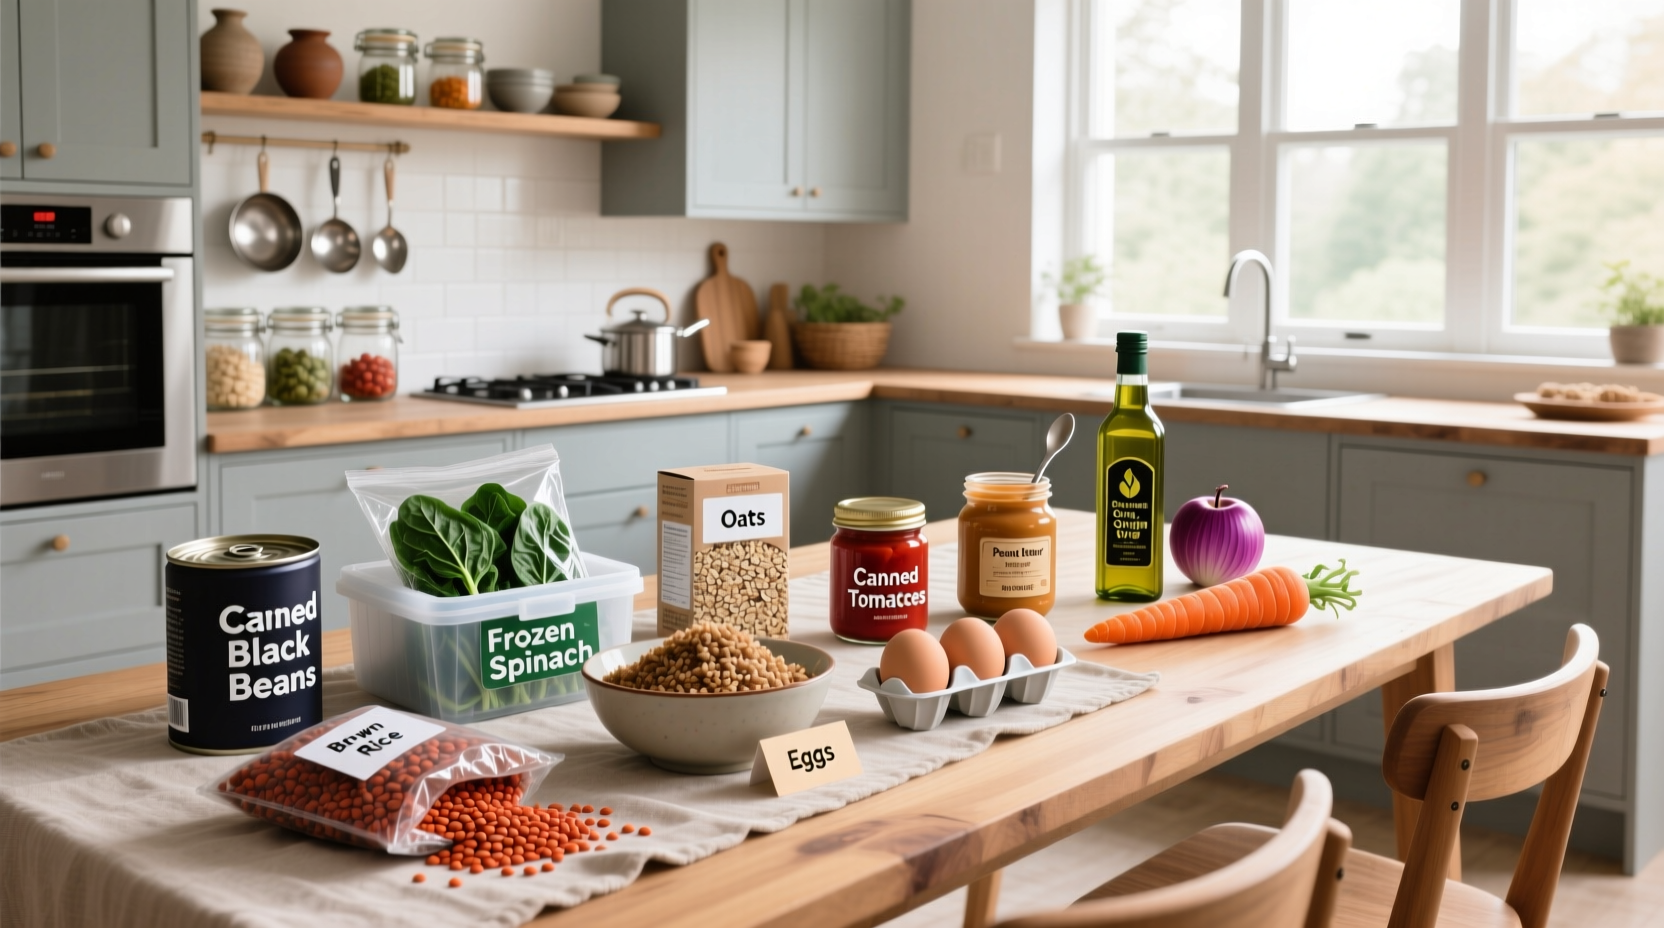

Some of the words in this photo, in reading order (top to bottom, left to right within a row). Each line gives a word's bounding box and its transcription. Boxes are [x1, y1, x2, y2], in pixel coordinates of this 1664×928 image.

[721, 509, 766, 528] Oats
[853, 565, 919, 586] Canned
[228, 629, 311, 668] Black
[487, 622, 575, 653] Frozen
[489, 640, 593, 683] Spinach
[229, 666, 317, 701] Beans
[356, 731, 404, 757] Rice
[787, 745, 835, 773] Eggs
